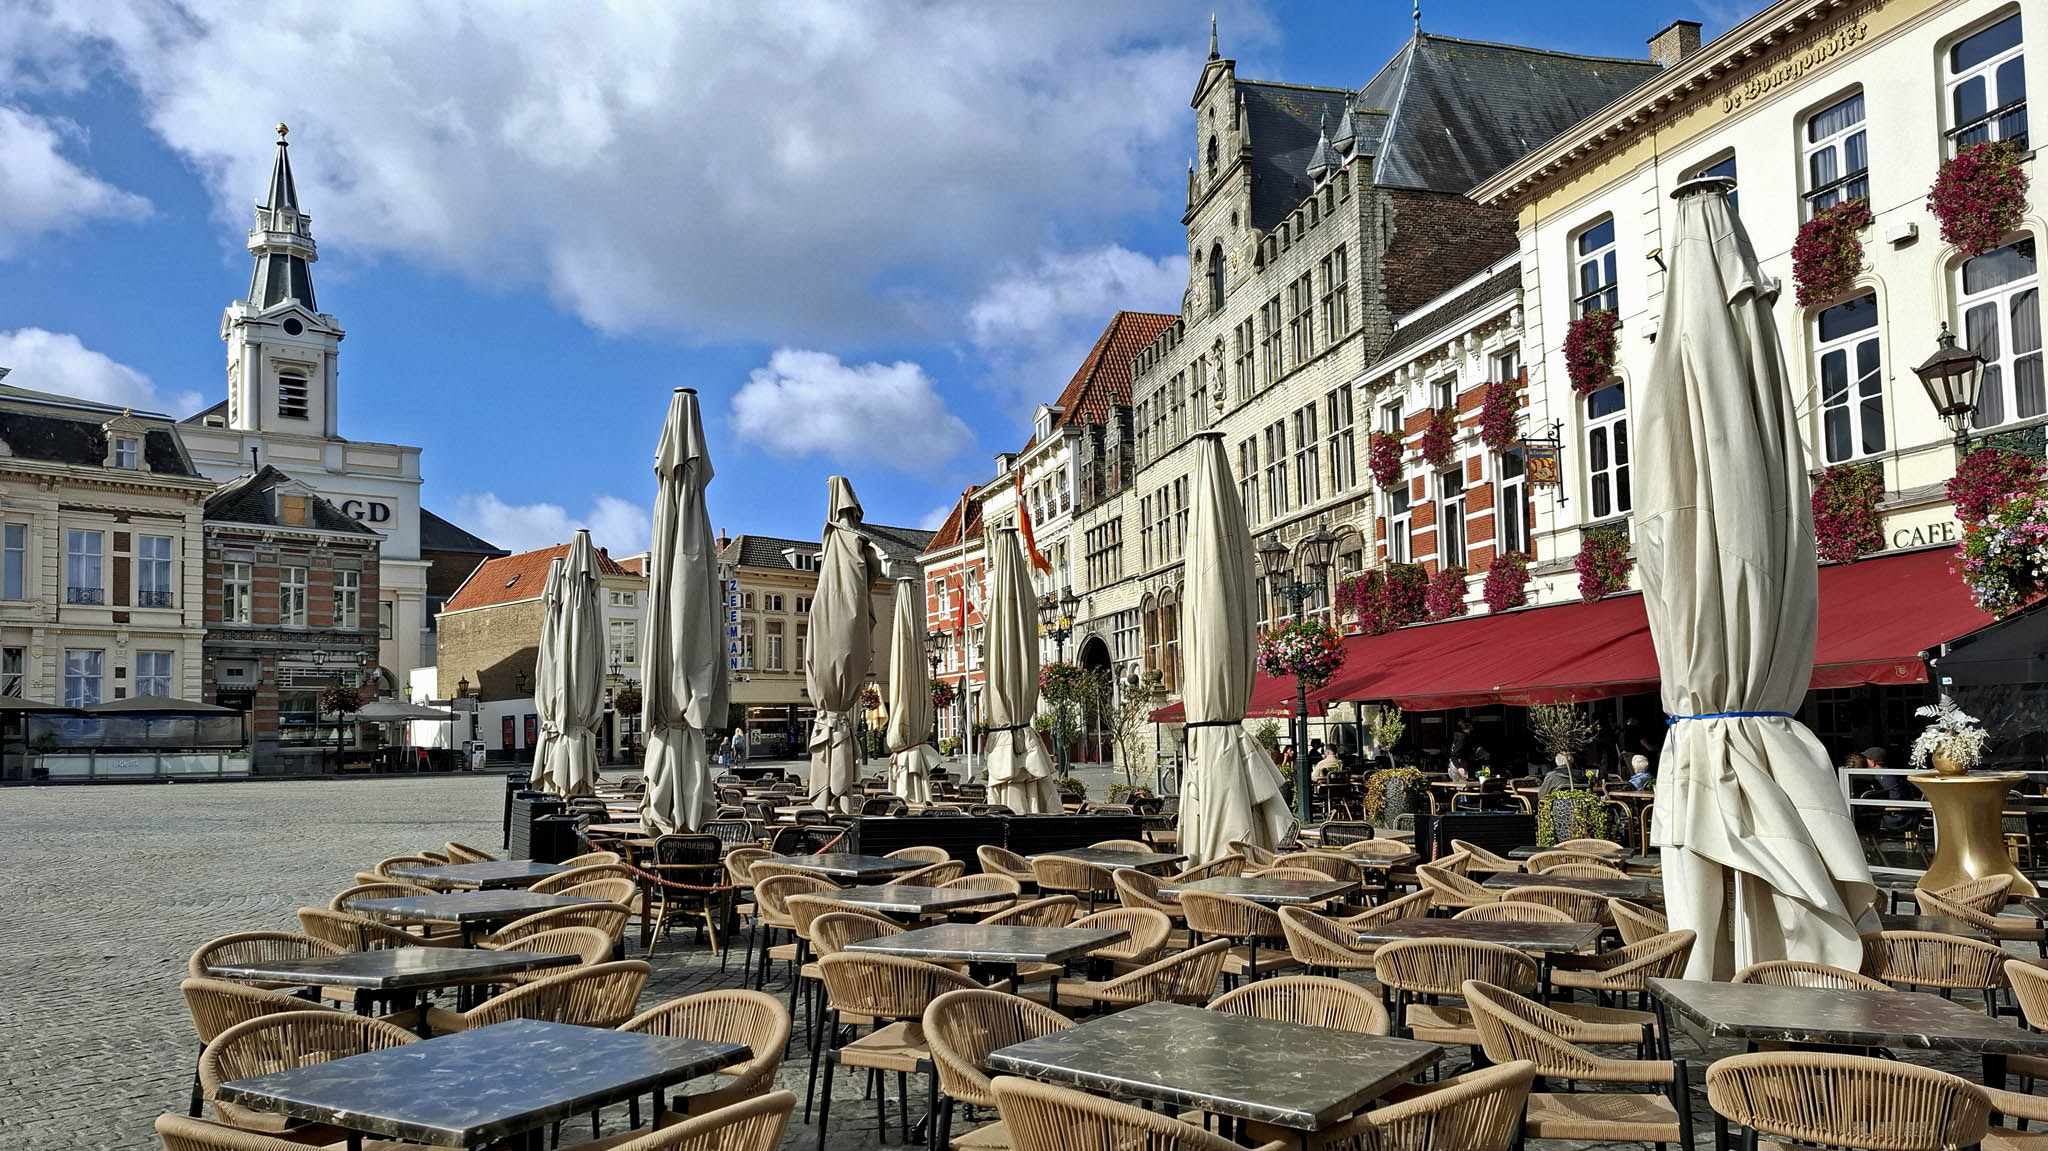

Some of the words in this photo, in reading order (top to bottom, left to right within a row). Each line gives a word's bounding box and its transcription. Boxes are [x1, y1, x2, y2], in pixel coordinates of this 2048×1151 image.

[1722, 92, 1742, 114] de
[1744, 22, 1868, 101] Bourgondiër
[326, 498, 391, 523] GD
[1893, 521, 1956, 549] CAFE
[729, 579, 738, 669] ZEEMAN
